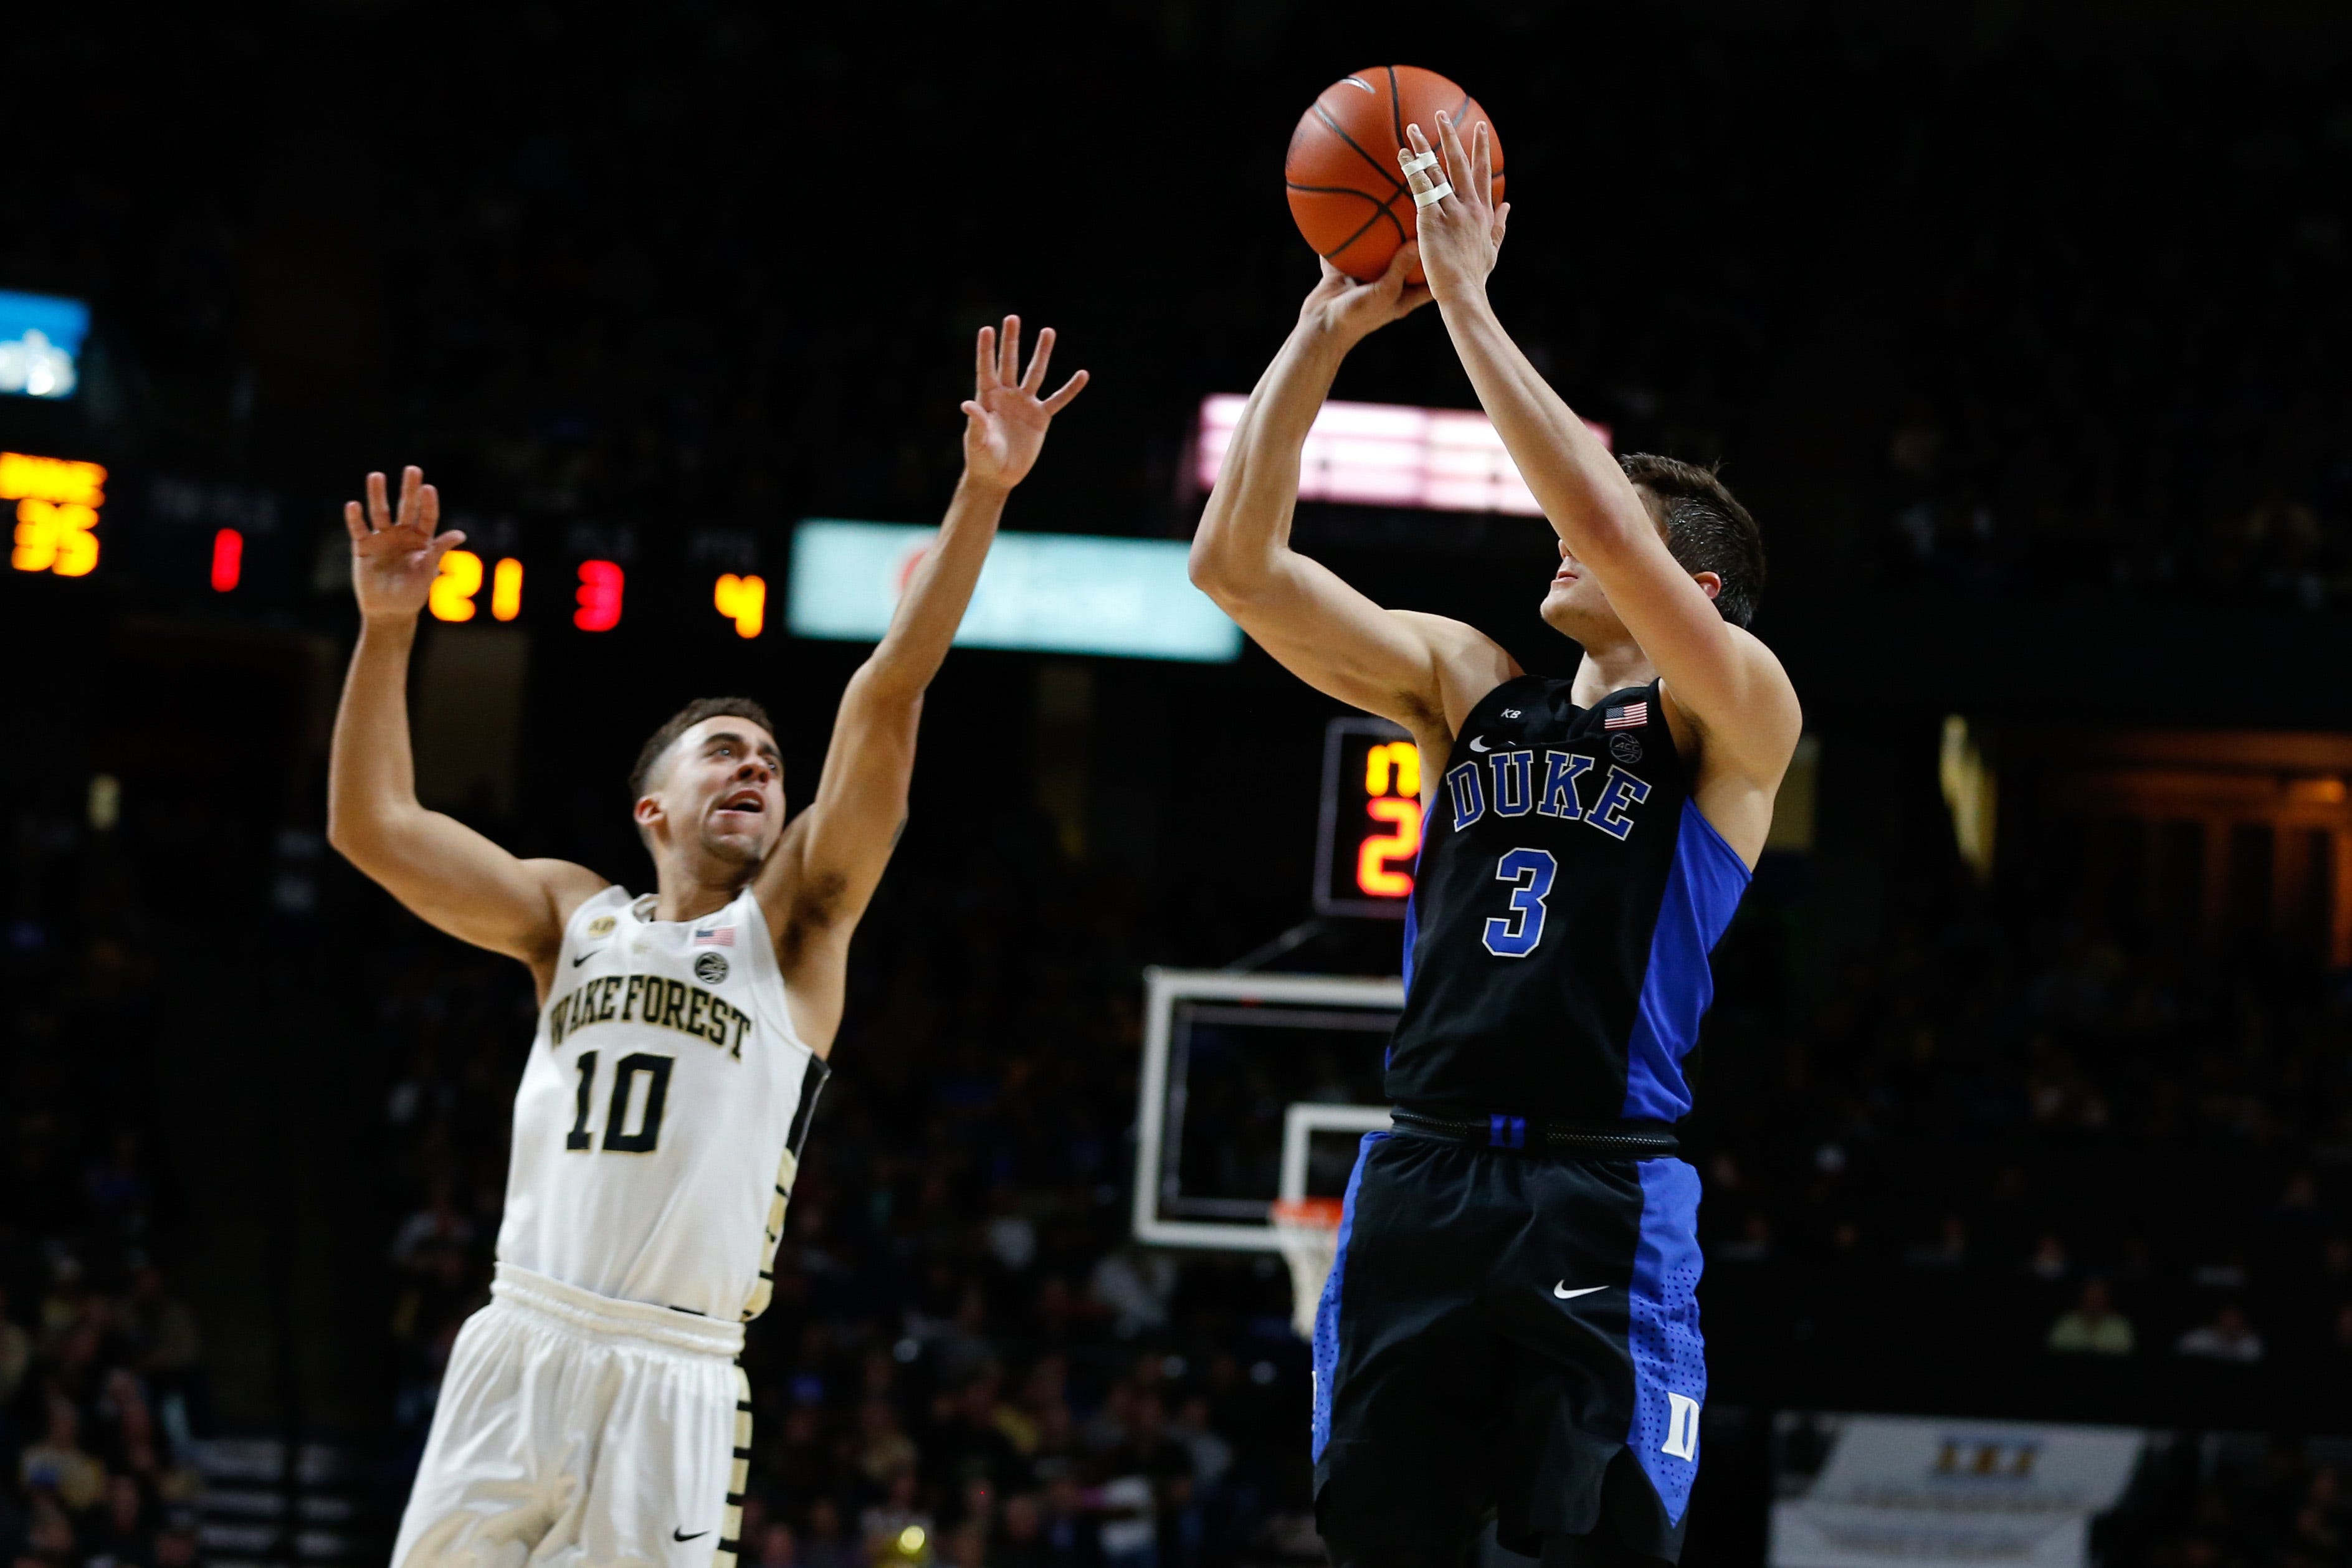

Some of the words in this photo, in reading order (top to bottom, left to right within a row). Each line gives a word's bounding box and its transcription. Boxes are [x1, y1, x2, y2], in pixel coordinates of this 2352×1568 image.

[429, 549, 523, 622] 21
[573, 559, 624, 632] 3
[1500, 708, 1522, 719] KB
[1445, 749, 1652, 841] DUKE
[1481, 847, 1558, 958] 3
[550, 975, 624, 1052] WAKE
[621, 974, 752, 1064] FOREST
[566, 1050, 678, 1156] 10
